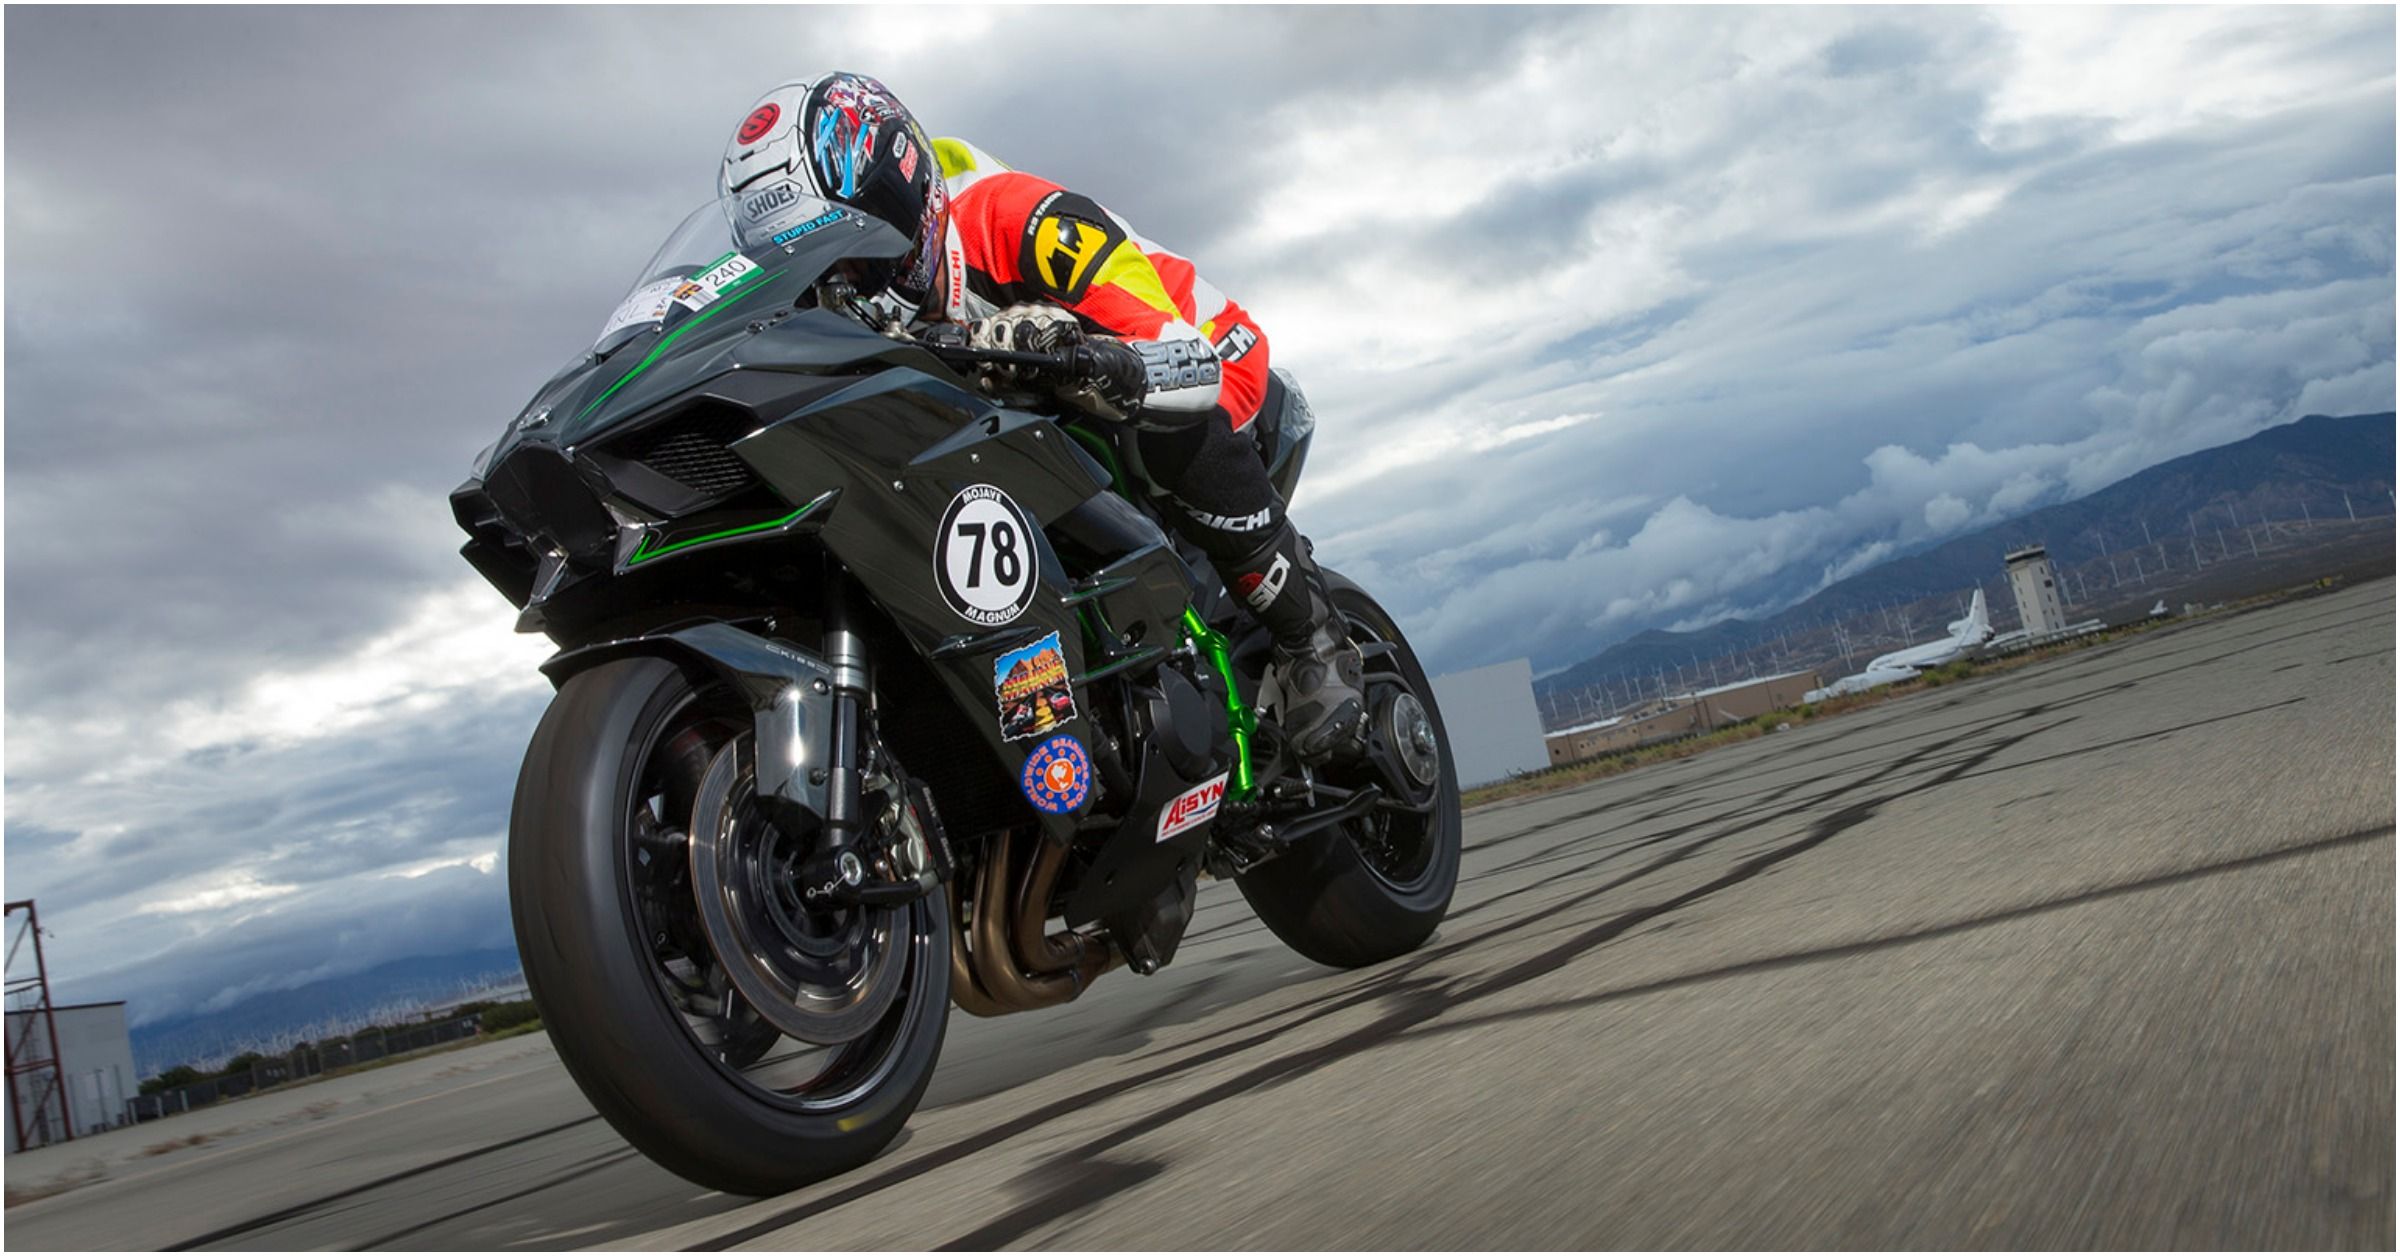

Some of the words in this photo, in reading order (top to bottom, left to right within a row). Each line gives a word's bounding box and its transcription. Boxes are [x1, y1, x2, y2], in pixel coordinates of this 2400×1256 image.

[747, 184, 795, 218] SHOEI
[773, 221, 816, 244] STUPID
[816, 208, 844, 226] FAST
[706, 259, 747, 287] 240
[951, 250, 961, 308] TAICHI
[962, 488, 1002, 504] MOJAVE
[957, 520, 1021, 588] 78
[964, 603, 1020, 623] MAGNUM
